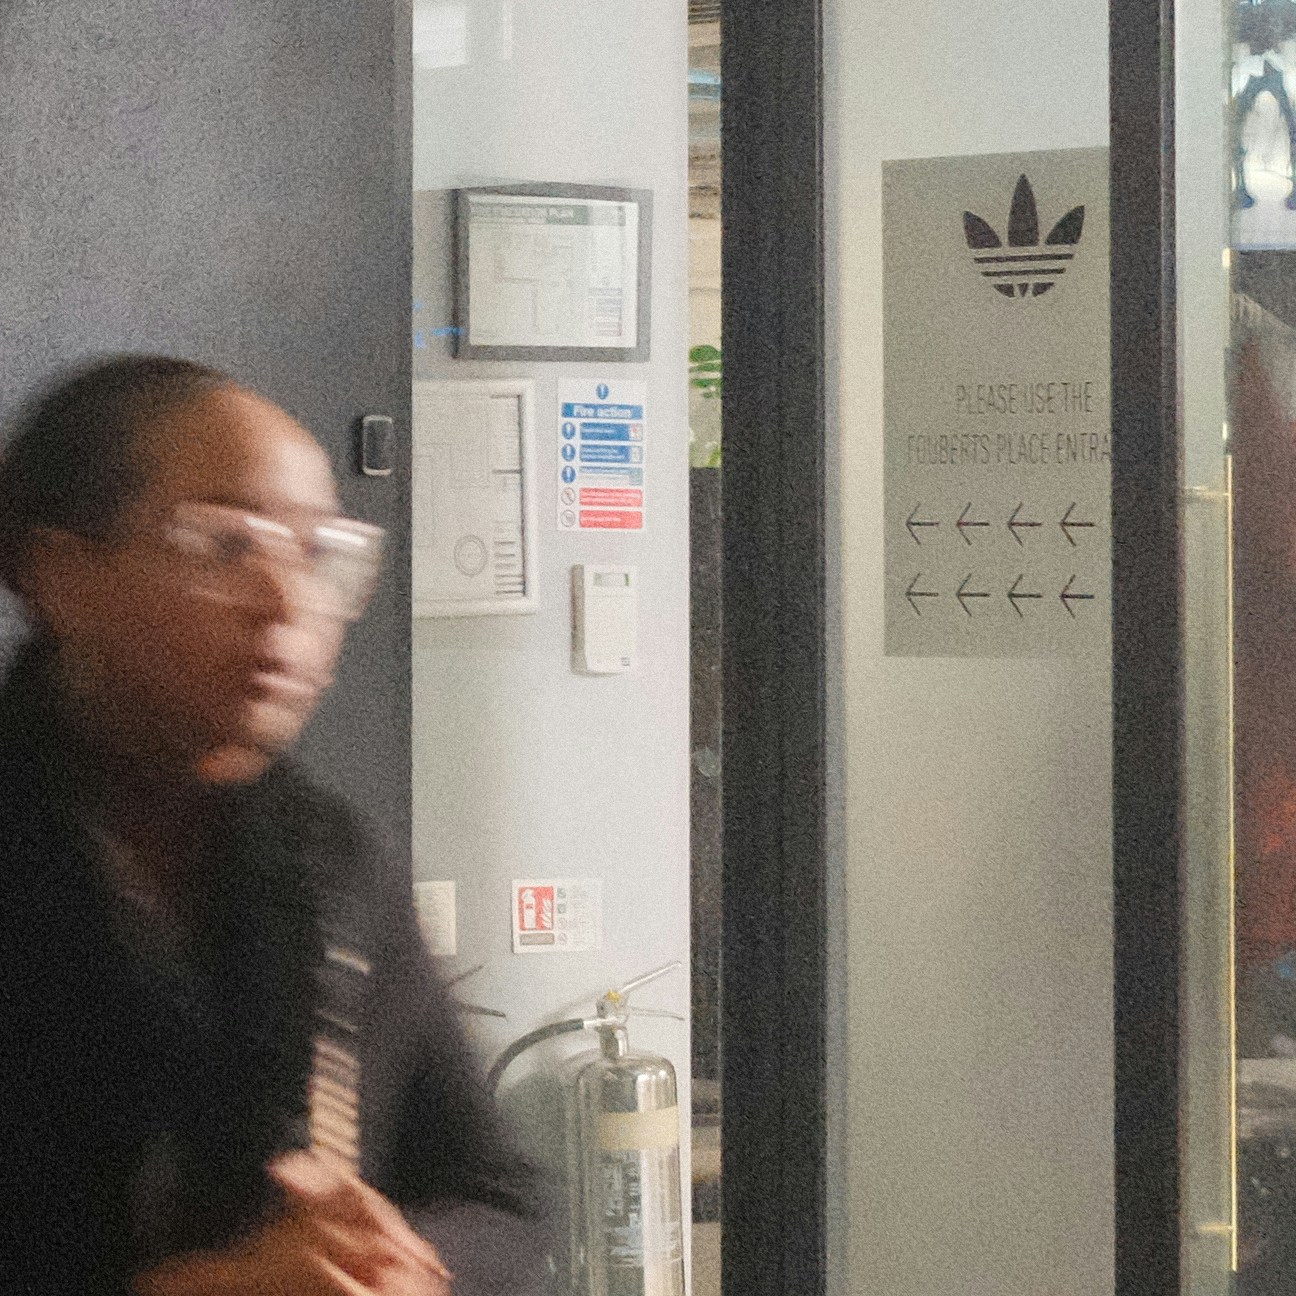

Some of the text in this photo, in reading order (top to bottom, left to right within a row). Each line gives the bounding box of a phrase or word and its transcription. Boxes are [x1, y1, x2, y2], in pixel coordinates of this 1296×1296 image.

[573, 405, 632, 419] Fire action
[957, 381, 1093, 414] PLEASE USE THE
[996, 433, 1050, 464] PLACE
